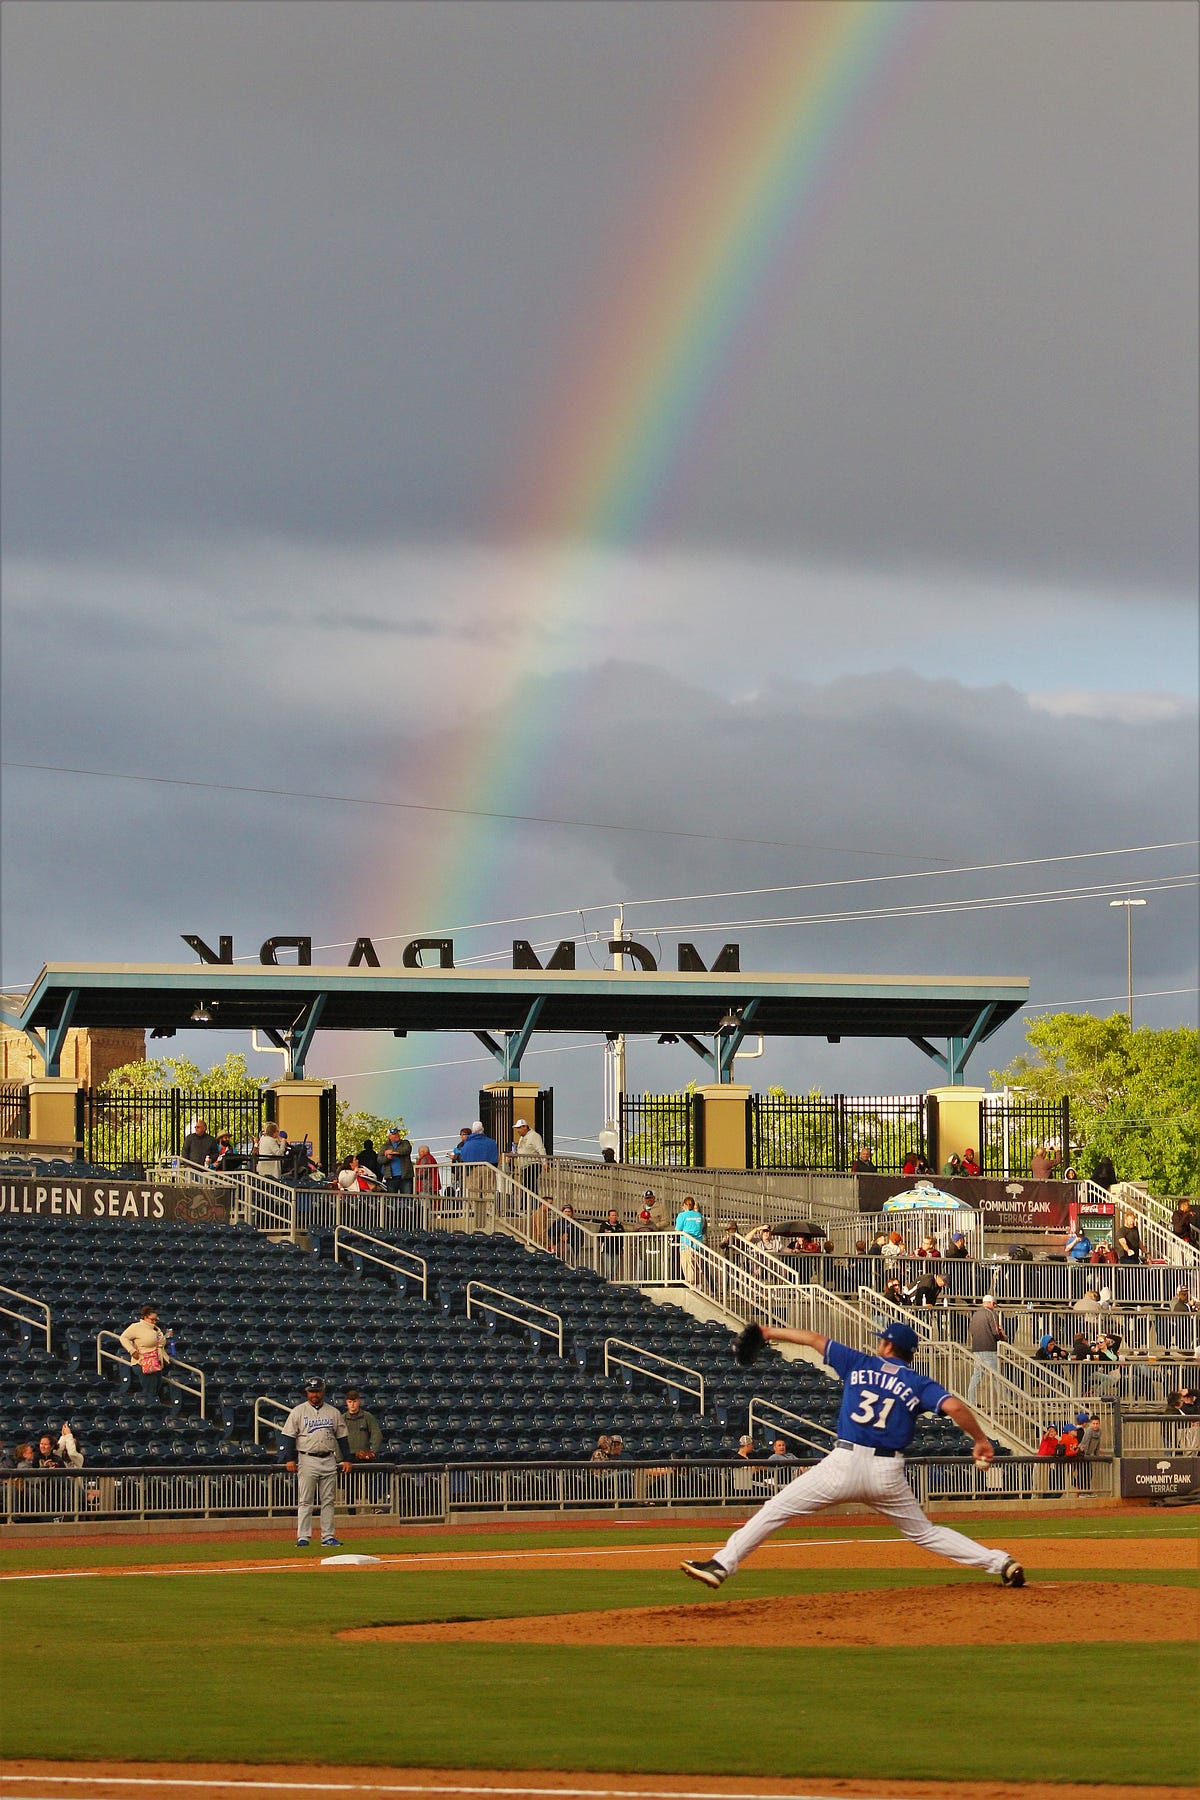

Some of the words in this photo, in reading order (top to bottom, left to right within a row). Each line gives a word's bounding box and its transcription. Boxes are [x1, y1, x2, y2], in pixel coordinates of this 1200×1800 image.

[93, 1188, 165, 1218] SEATS
[979, 1199, 1027, 1213] COMMUNITY
[1027, 1200, 1051, 1213] BANK
[998, 1212, 1033, 1224] TERRACE
[850, 1369, 920, 1412] BETTINGER
[850, 1389, 896, 1429] 31
[1135, 1474, 1173, 1484] COMMUNITY
[1173, 1473, 1192, 1484] BANK
[1150, 1484, 1178, 1493] TERRACE
